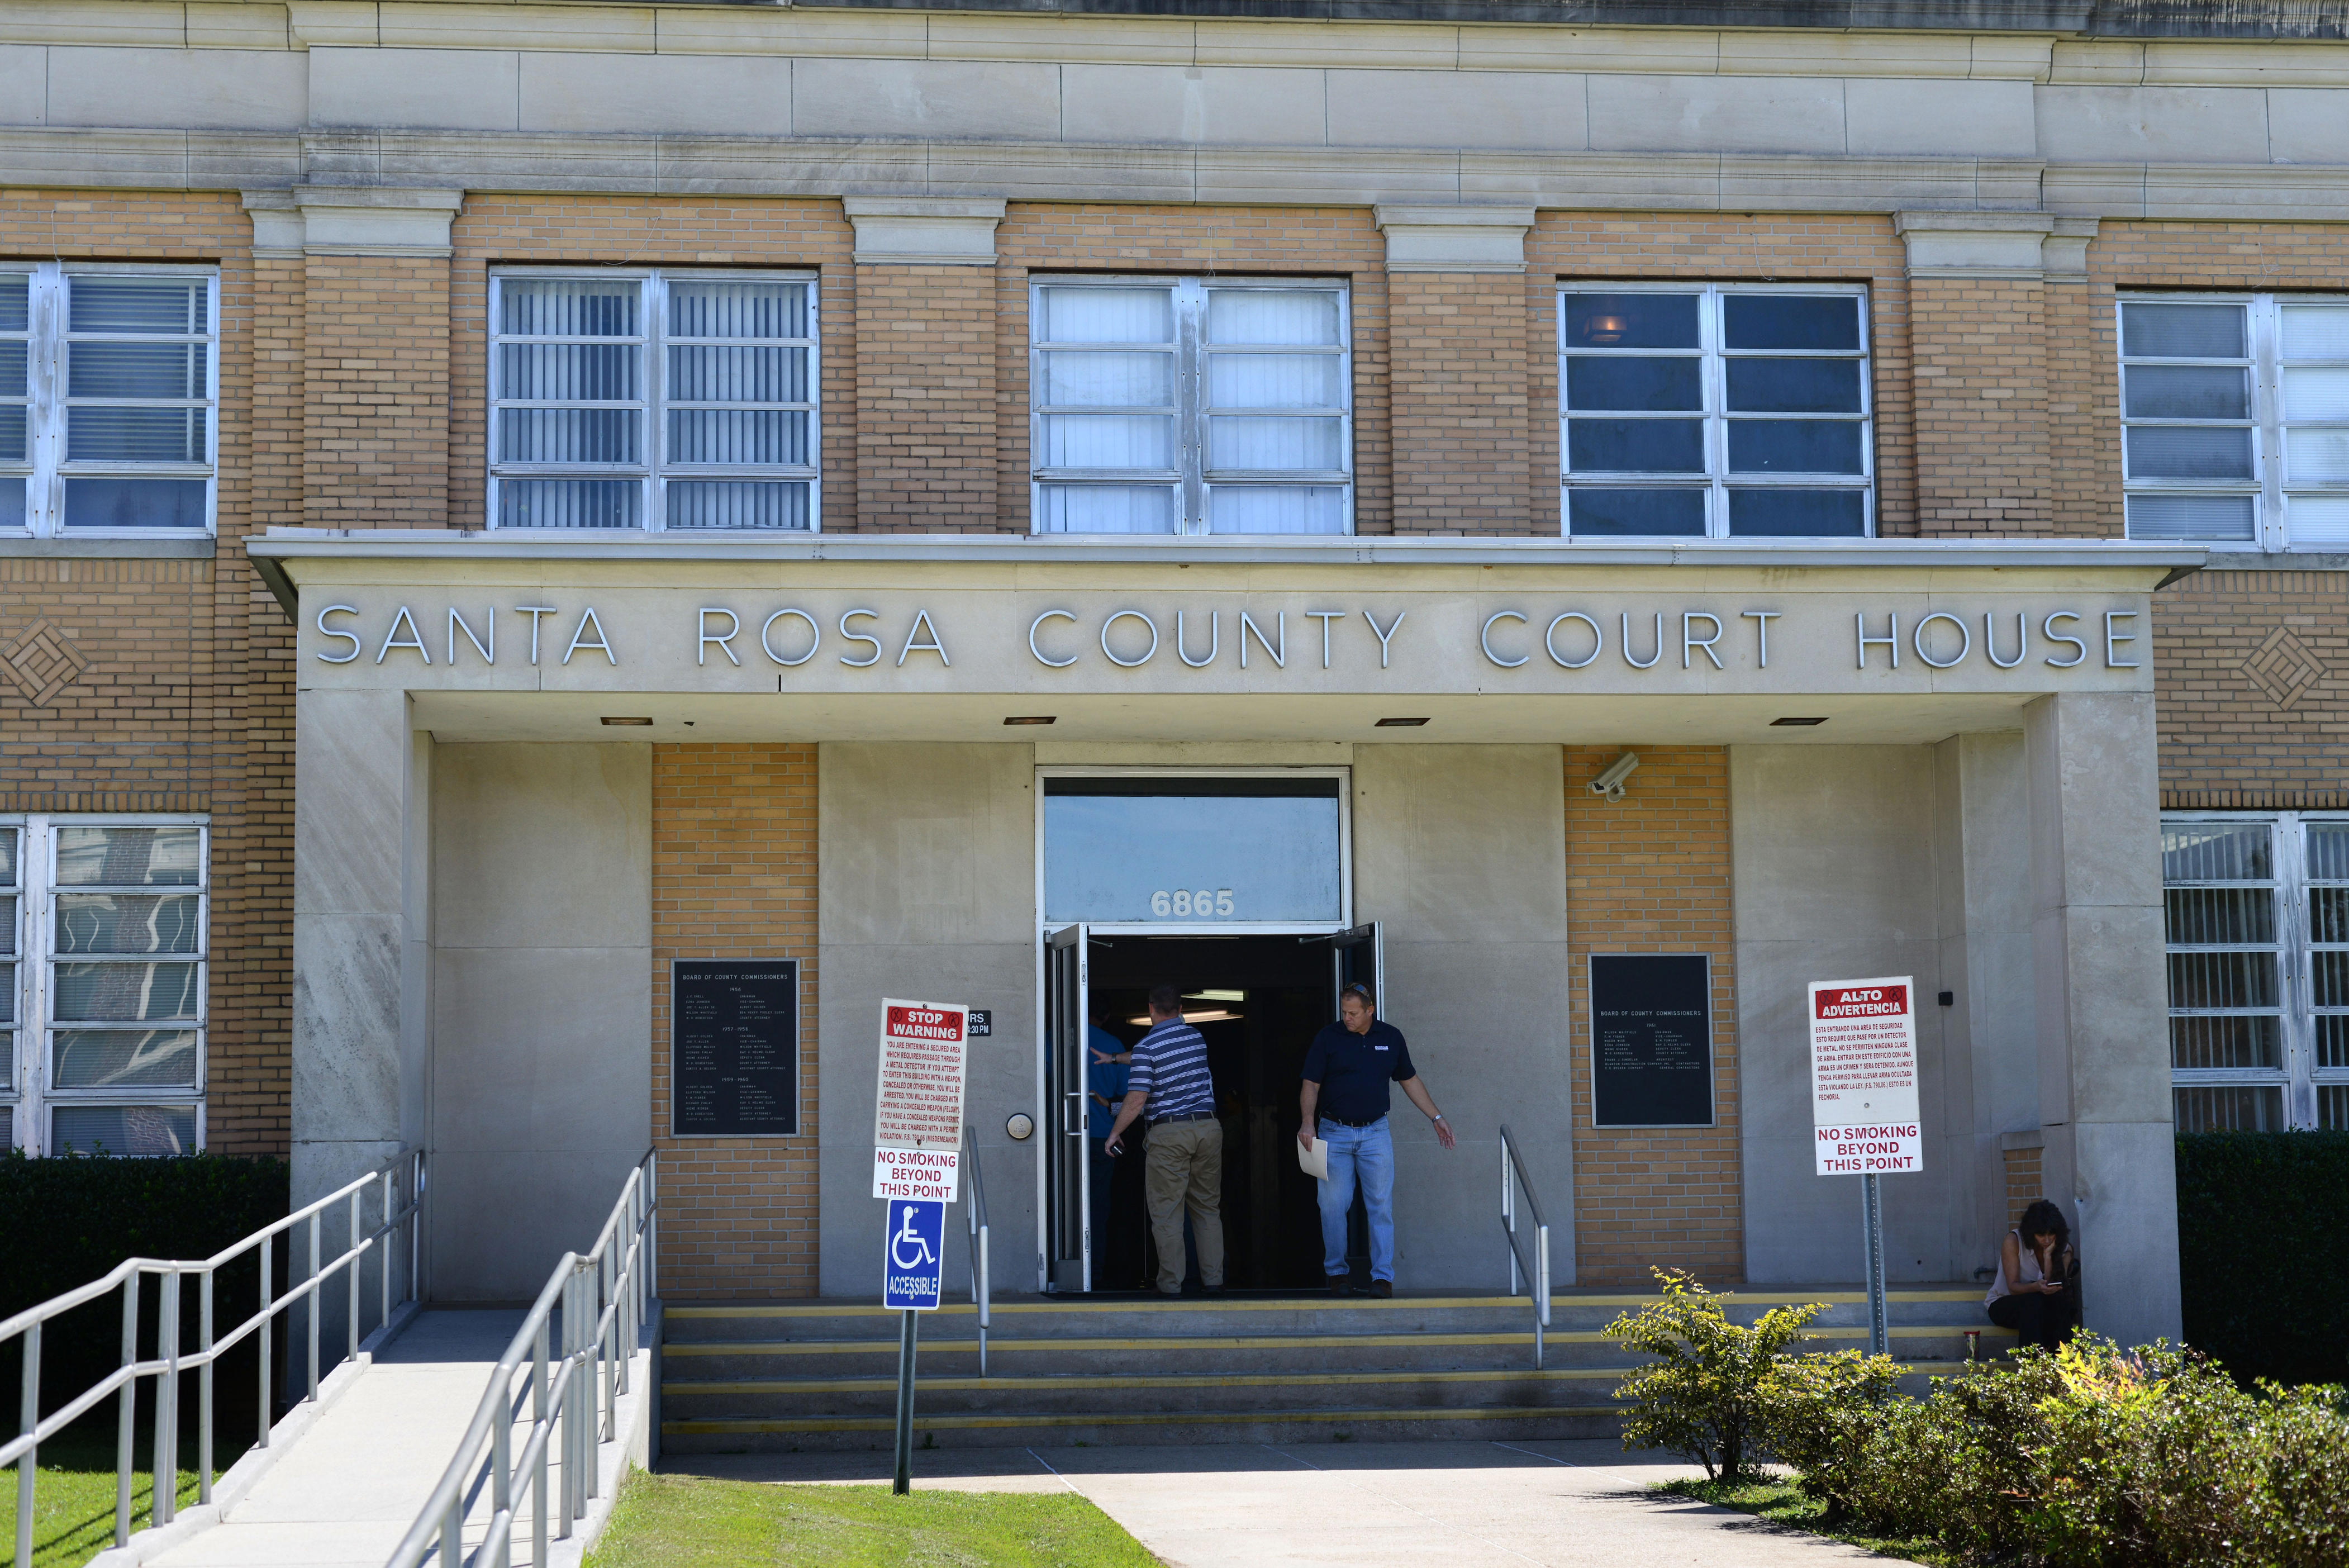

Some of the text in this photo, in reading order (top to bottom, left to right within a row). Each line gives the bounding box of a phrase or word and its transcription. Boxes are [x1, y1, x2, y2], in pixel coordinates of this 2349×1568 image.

[316, 605, 2139, 670] SANTA ROSA COUNTY COURT HOUSE
[1151, 890, 1234, 916] 6865
[1841, 990, 1882, 1002] ALTO
[1823, 1002, 1901, 1016] ADVERTENCIA
[908, 1011, 943, 1024] STOP
[968, 1013, 983, 1023] RS
[893, 1024, 957, 1039] WARNING
[913, 1082, 935, 1091] OTHERWISE,
[906, 1113, 928, 1121] CONCEALED
[926, 1135, 958, 1143] (MISDEMEANOR)
[1818, 1125, 1917, 1141] NO SMOKING
[1838, 1142, 1899, 1155] BEYOND
[878, 1152, 955, 1167] NO SMOKING
[1824, 1157, 1913, 1171] THIS POINT
[892, 1168, 941, 1181] BEYOND
[880, 1183, 951, 1198] THIS POINT
[889, 1276, 936, 1295] ACCESSIBLE
